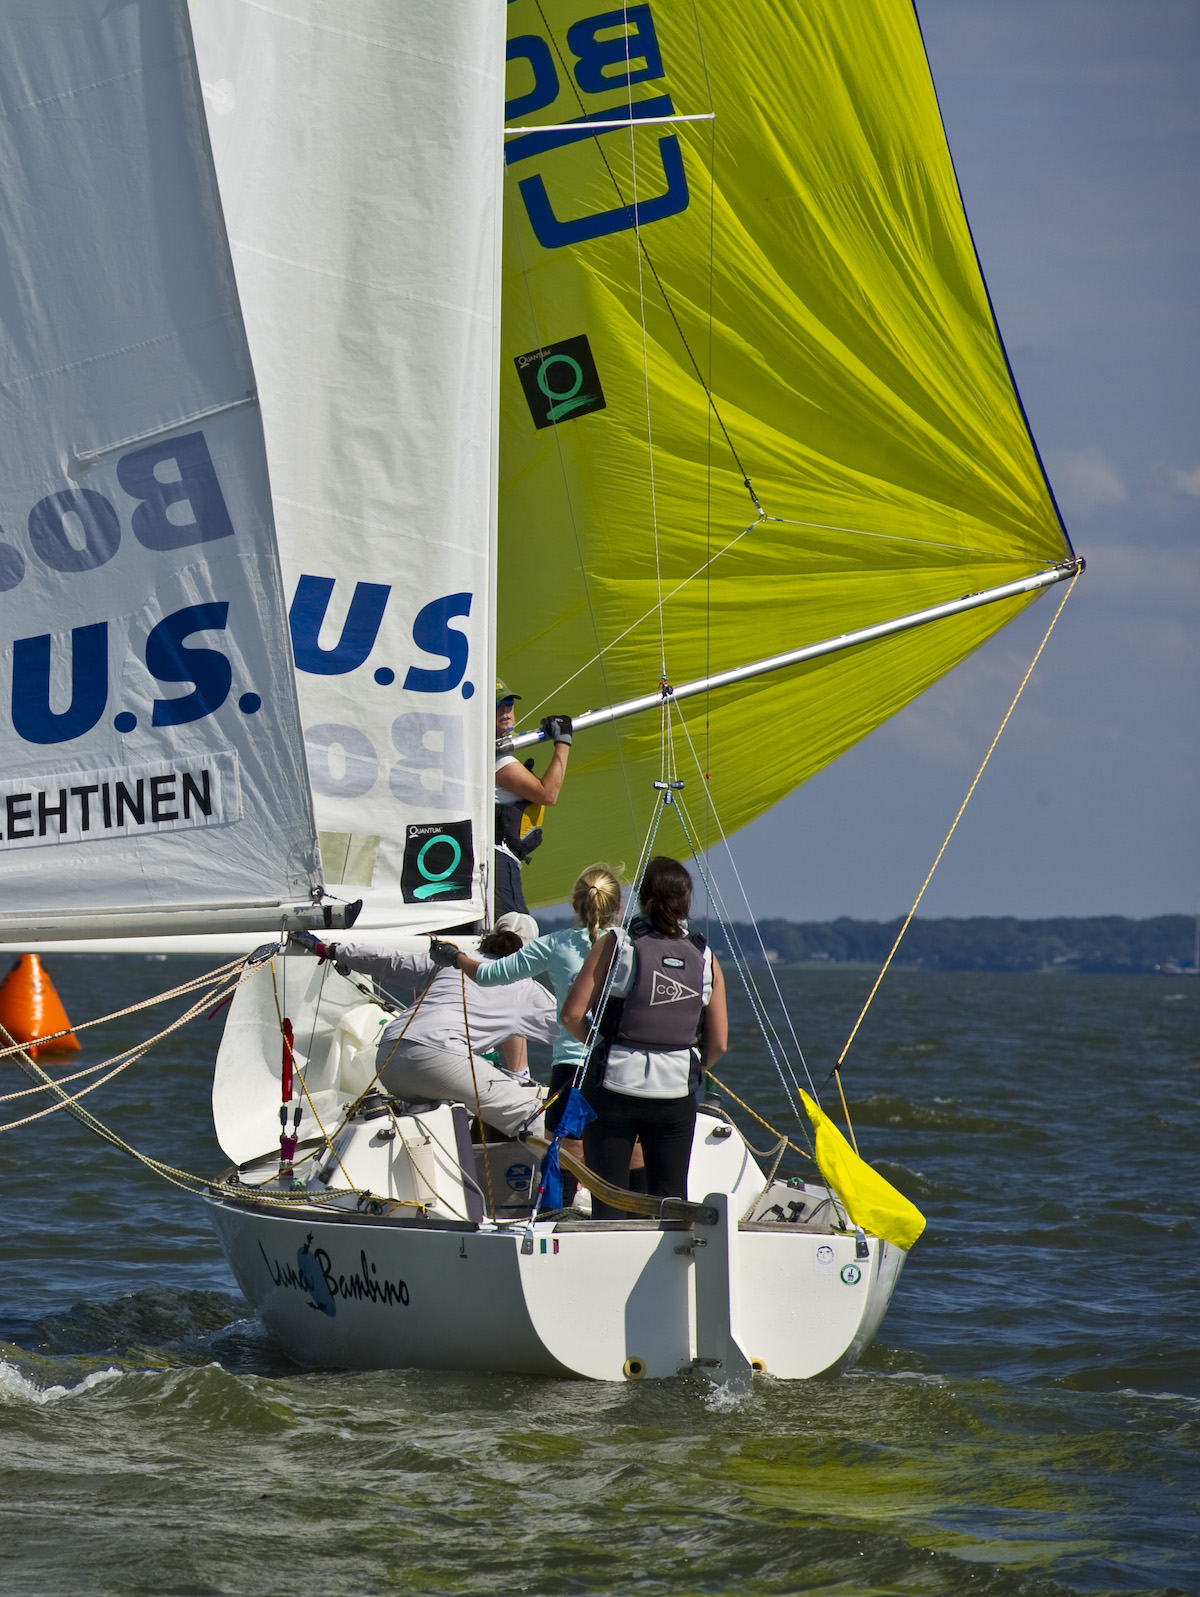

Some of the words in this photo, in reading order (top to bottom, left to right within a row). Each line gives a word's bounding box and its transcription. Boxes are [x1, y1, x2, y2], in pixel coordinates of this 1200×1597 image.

[289, 574, 475, 700] U.S.
[12, 602, 261, 744] U.S.
[409, 826, 441, 838] QUANTUM
[656, 984, 676, 996] CC
[314, 1248, 410, 1307] Bambino
